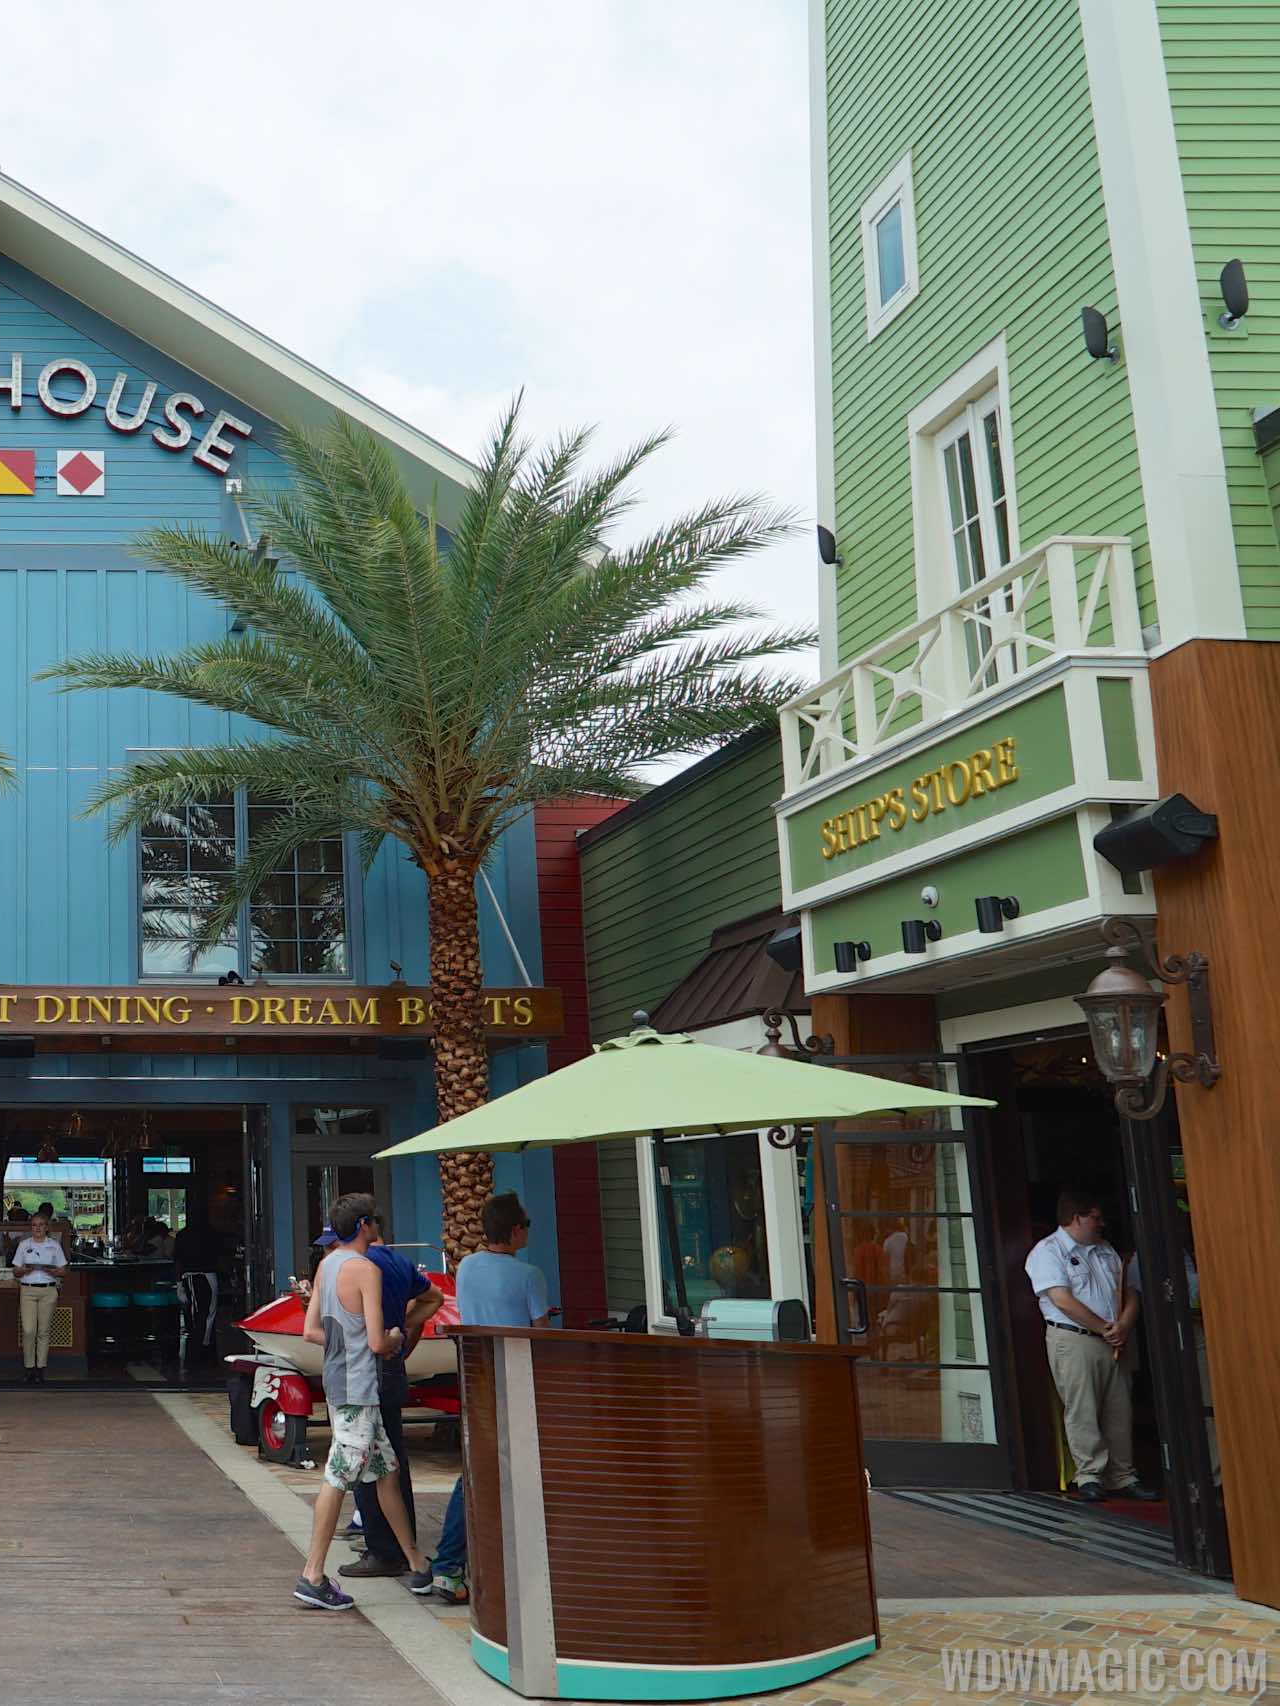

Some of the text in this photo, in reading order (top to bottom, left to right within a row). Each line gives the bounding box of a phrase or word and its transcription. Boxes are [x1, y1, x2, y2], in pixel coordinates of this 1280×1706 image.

[910, 735, 1020, 823] STORE
[33, 994, 191, 1025] DINING
[229, 995, 380, 1026] DREAM
[397, 996, 534, 1027] BTS
